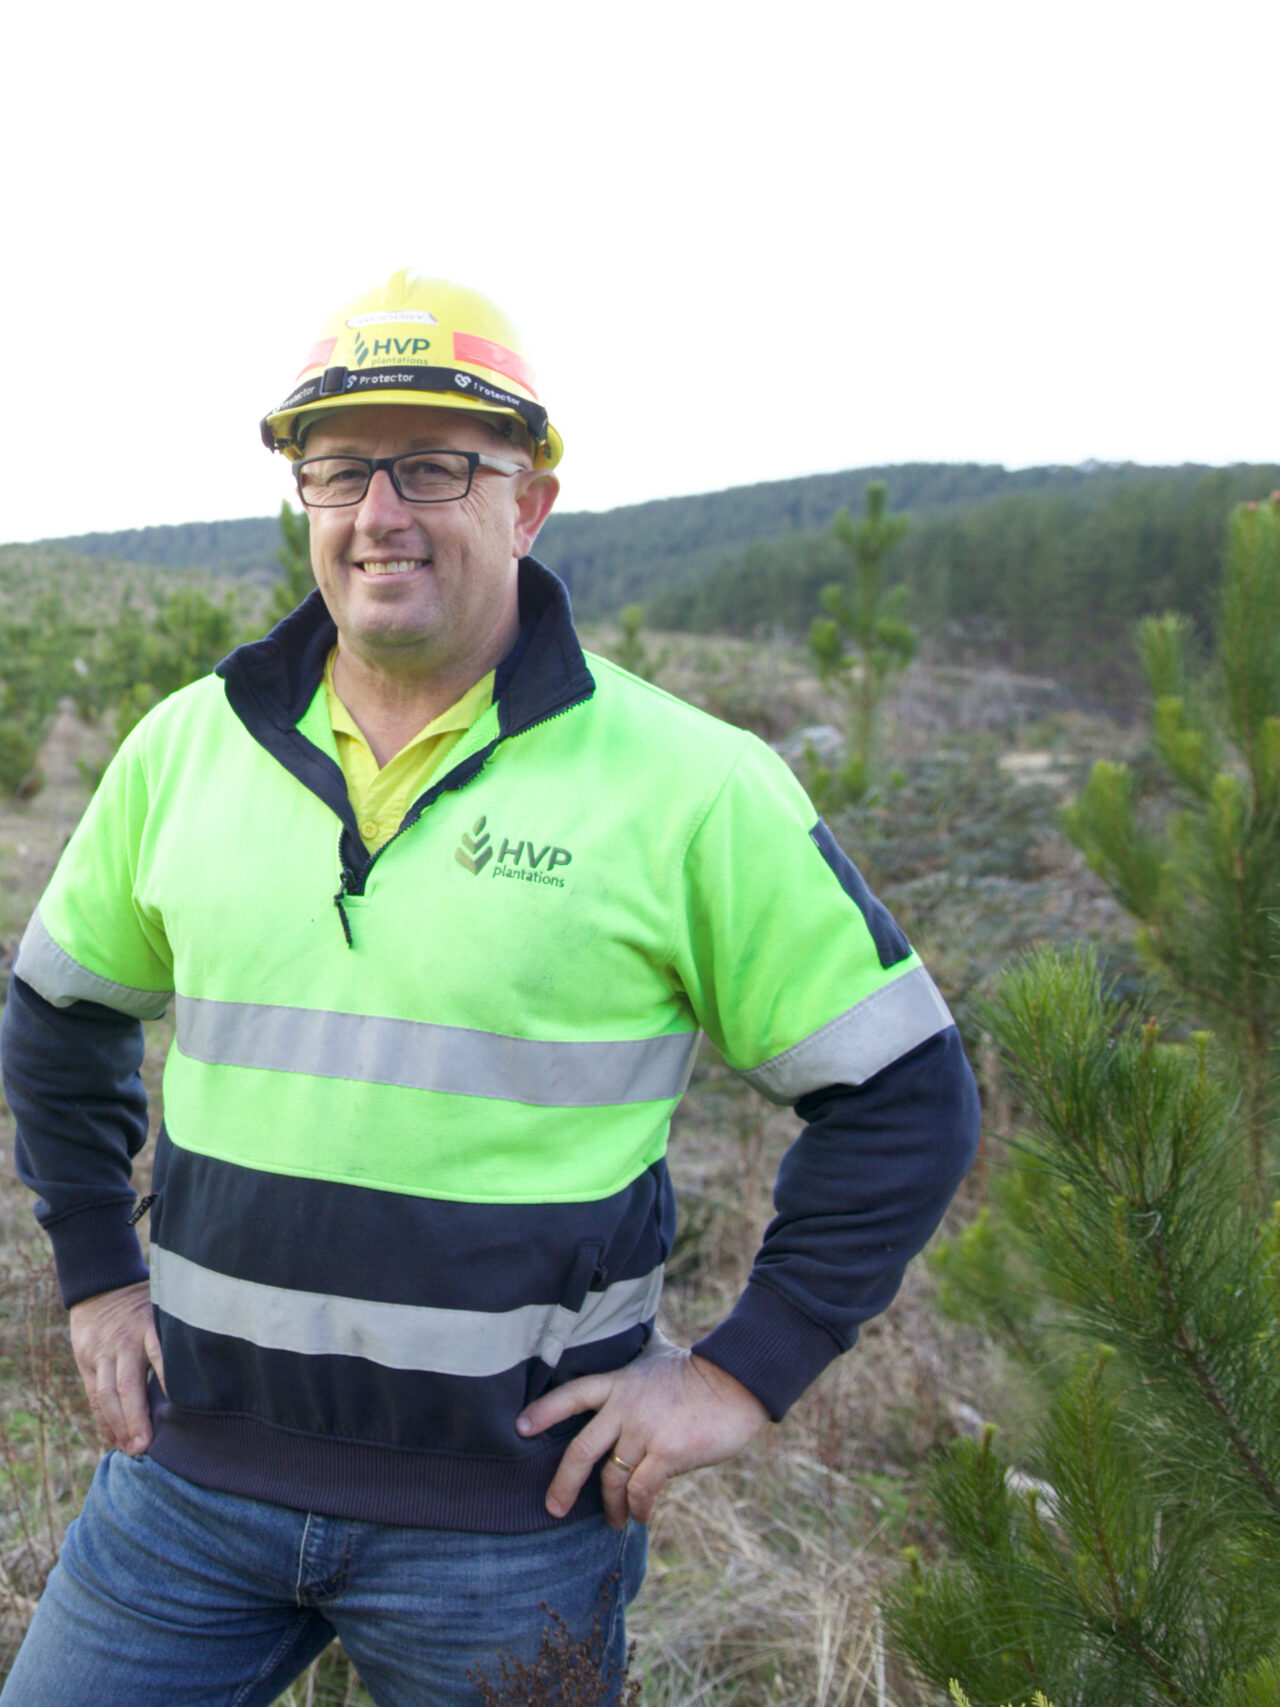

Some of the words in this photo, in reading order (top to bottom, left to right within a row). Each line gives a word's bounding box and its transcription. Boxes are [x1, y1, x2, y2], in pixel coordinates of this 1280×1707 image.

[373, 337, 431, 356] HVP
[371, 356, 428, 367] plantations
[359, 373, 415, 385] Protector
[497, 838, 573, 872] HVP
[492, 865, 565, 888] plantations
